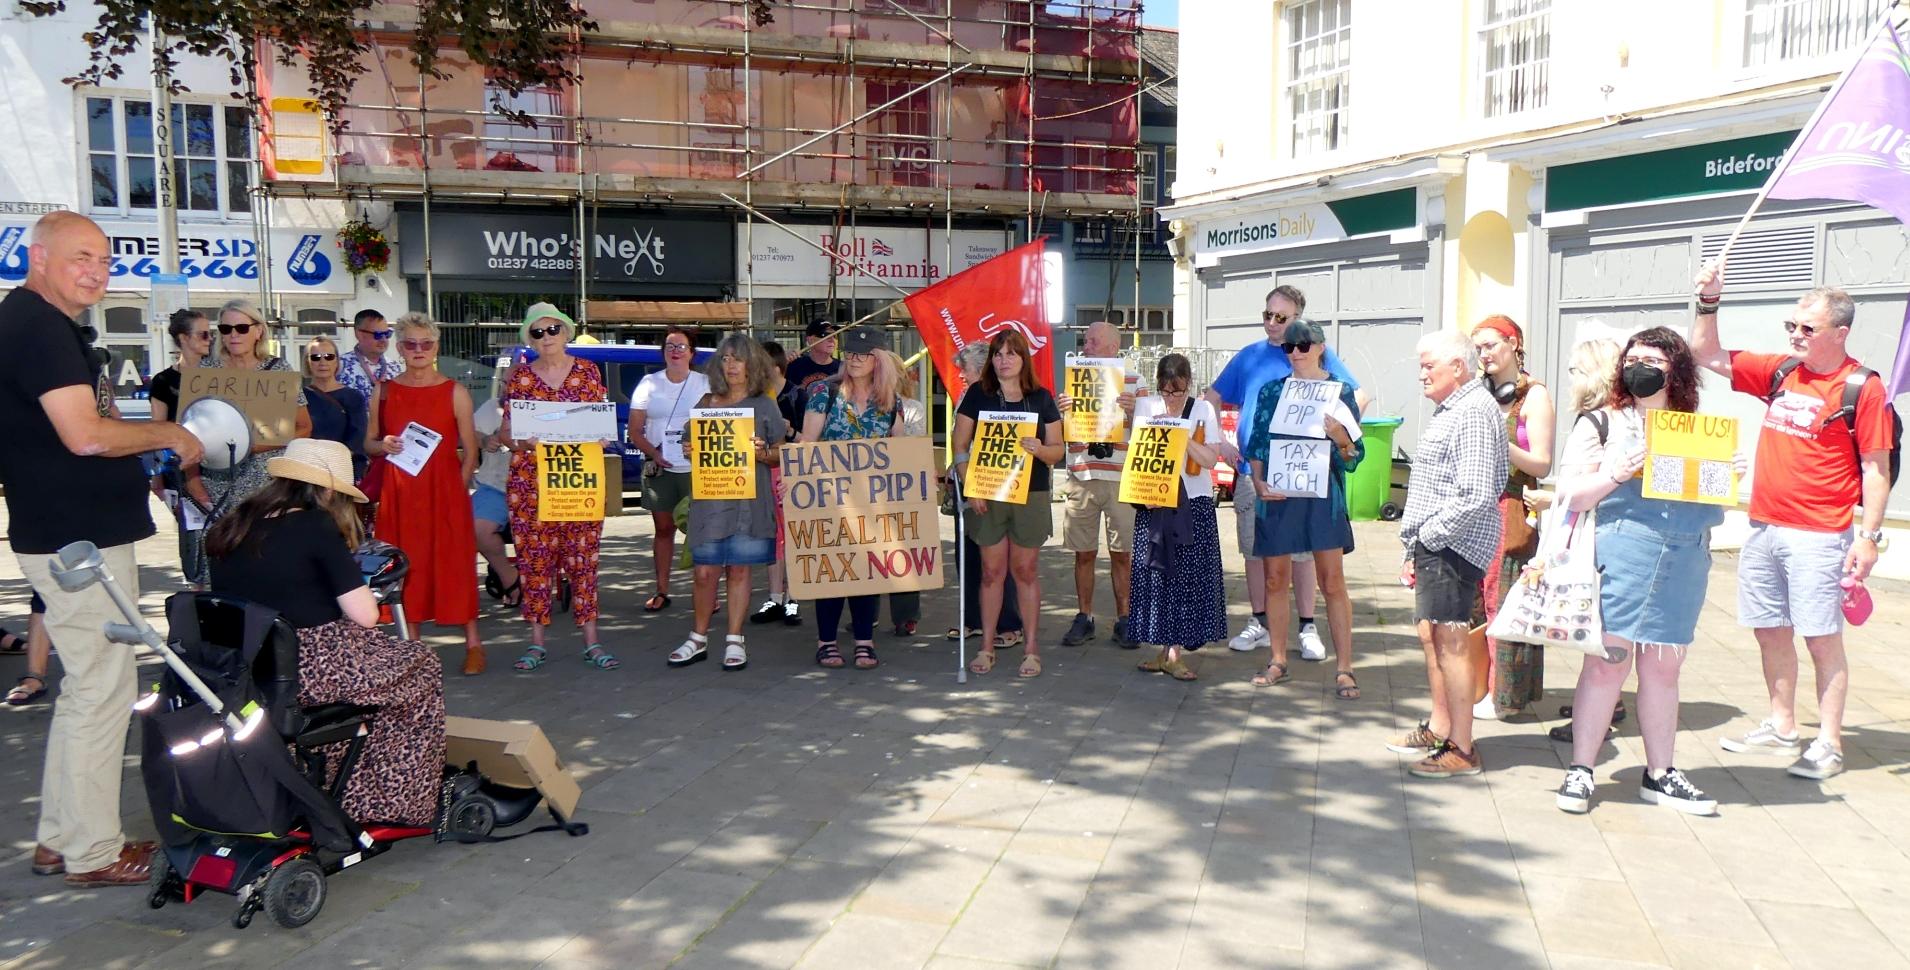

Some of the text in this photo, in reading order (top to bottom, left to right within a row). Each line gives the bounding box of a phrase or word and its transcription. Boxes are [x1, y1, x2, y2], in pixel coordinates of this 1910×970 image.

[156, 107, 172, 208] SQUARE
[1705, 149, 1789, 177] Bideford
[1207, 212, 1316, 248] Morrisons Daily
[483, 228, 665, 272] Who's Next
[819, 234, 865, 258] Roll
[488, 257, 528, 269] 01237
[834, 258, 940, 278] Britannia
[1071, 368, 1106, 383] TAX
[189, 375, 288, 402] CARING
[1071, 384, 1106, 398] THE
[1285, 380, 1340, 403] PROTECT
[512, 401, 615, 412] CUTS HURT
[1283, 404, 1316, 425] PIP
[697, 419, 736, 435] TAX
[984, 422, 1018, 438] TAX
[1139, 427, 1172, 443] TAX
[1703, 418, 1731, 438] US!
[542, 444, 584, 457] TAX
[697, 436, 735, 451] THE
[980, 437, 1017, 453] THE
[1135, 442, 1168, 458] THE
[1279, 443, 1318, 460] TAX
[544, 457, 584, 472] THE
[699, 452, 747, 467] RICH
[782, 441, 891, 477] HANDS
[976, 451, 1026, 471] RICH
[1130, 457, 1175, 475] RICH
[1285, 462, 1309, 471] THE
[547, 472, 598, 488] RICH
[1273, 472, 1318, 492] RICH
[790, 476, 852, 510] OFF
[787, 511, 920, 549] WEALTH
[796, 546, 937, 584] TAX NOW
